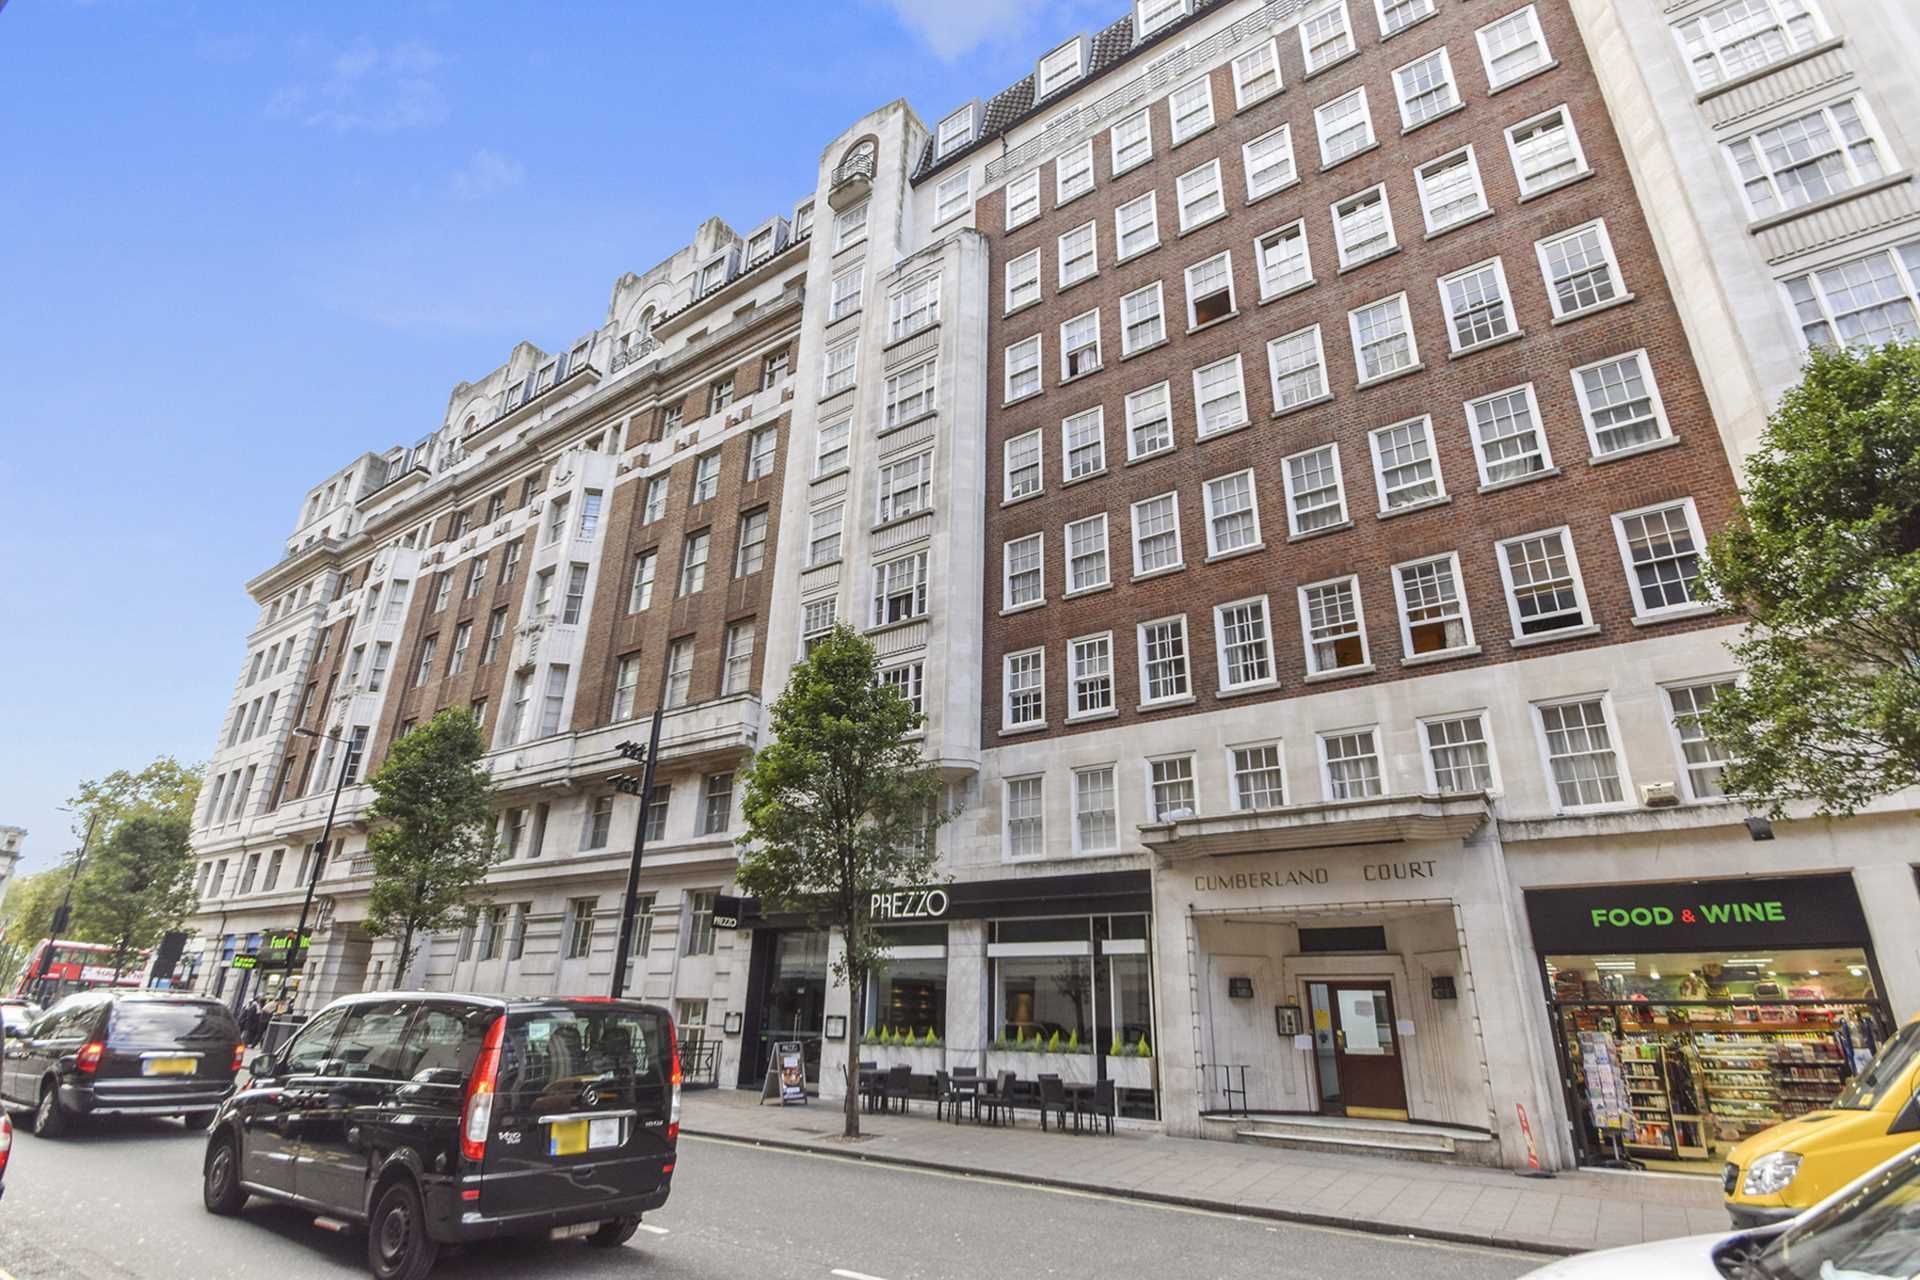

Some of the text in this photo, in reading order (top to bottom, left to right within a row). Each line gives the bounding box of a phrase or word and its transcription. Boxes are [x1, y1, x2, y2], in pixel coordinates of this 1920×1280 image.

[1195, 860, 1437, 892] CUMBERLAND COURT
[870, 889, 947, 919] PREZZO
[1591, 902, 1786, 928] FOOD & WINE
[713, 915, 737, 928] PREZZO
